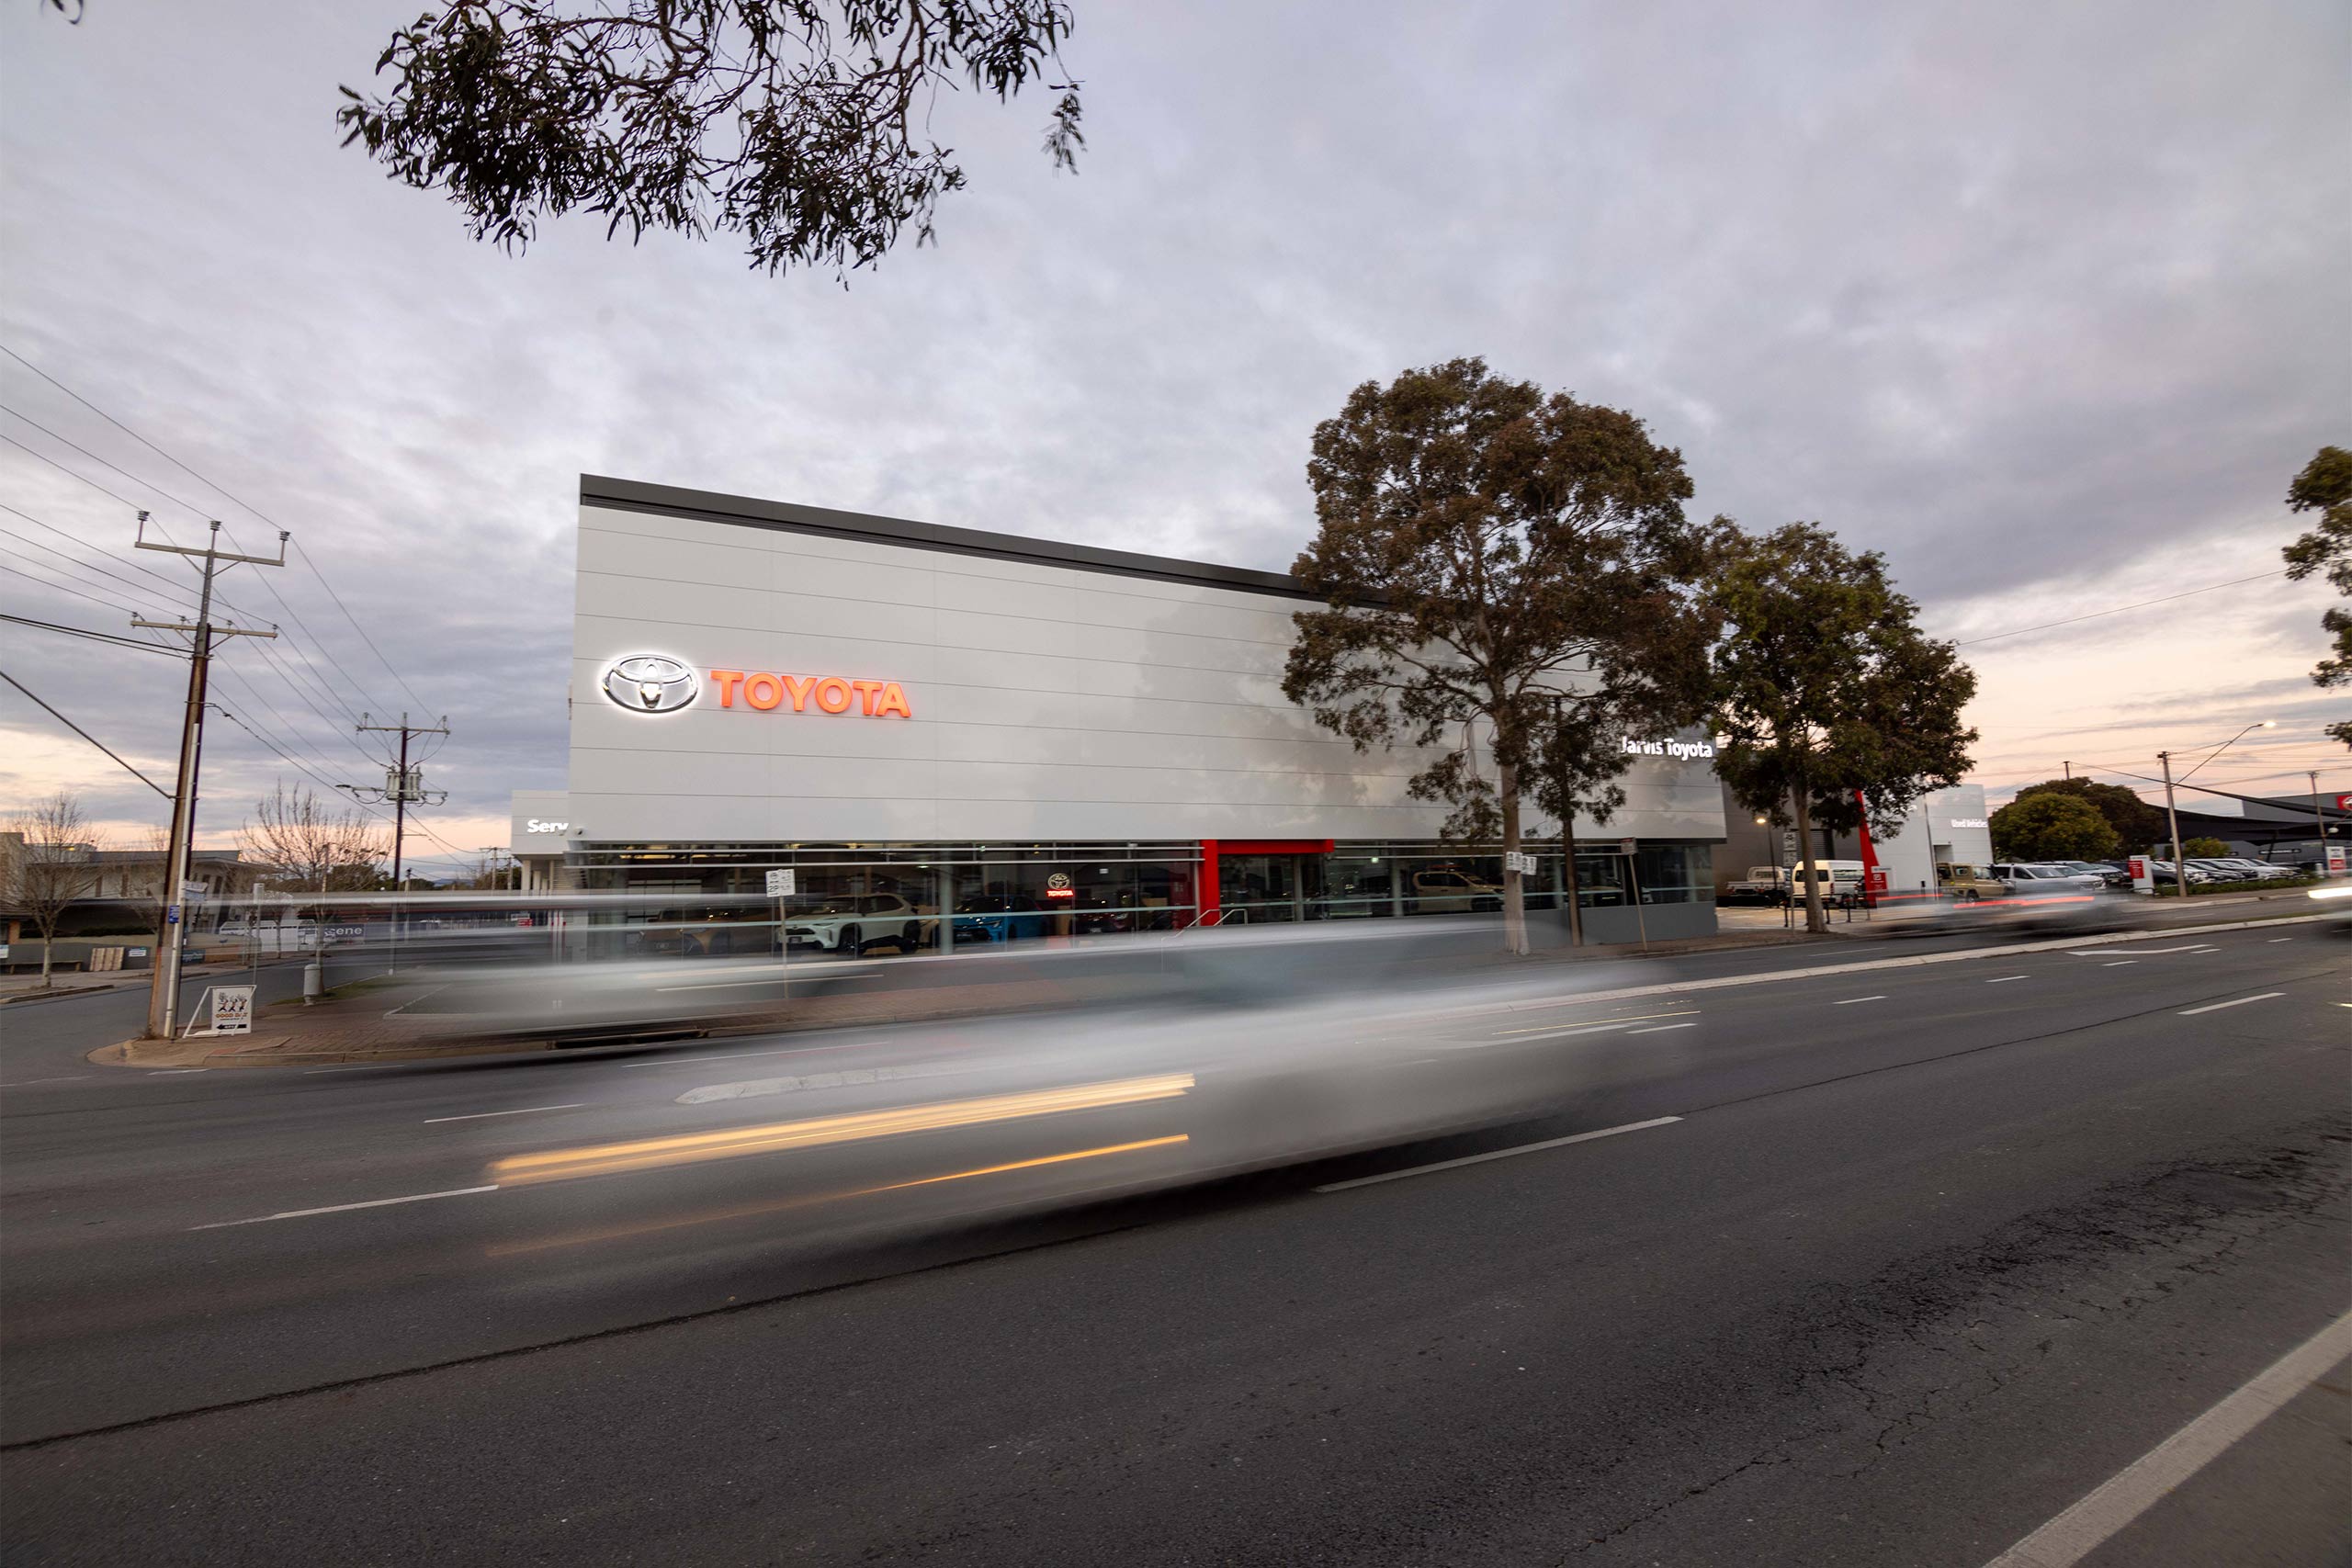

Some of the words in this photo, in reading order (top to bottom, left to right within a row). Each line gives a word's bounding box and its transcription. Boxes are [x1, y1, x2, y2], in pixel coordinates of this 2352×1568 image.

[710, 671, 911, 718] TOYOTA
[1621, 736, 1663, 755] Jarvis
[1664, 738, 1713, 761] Toyota
